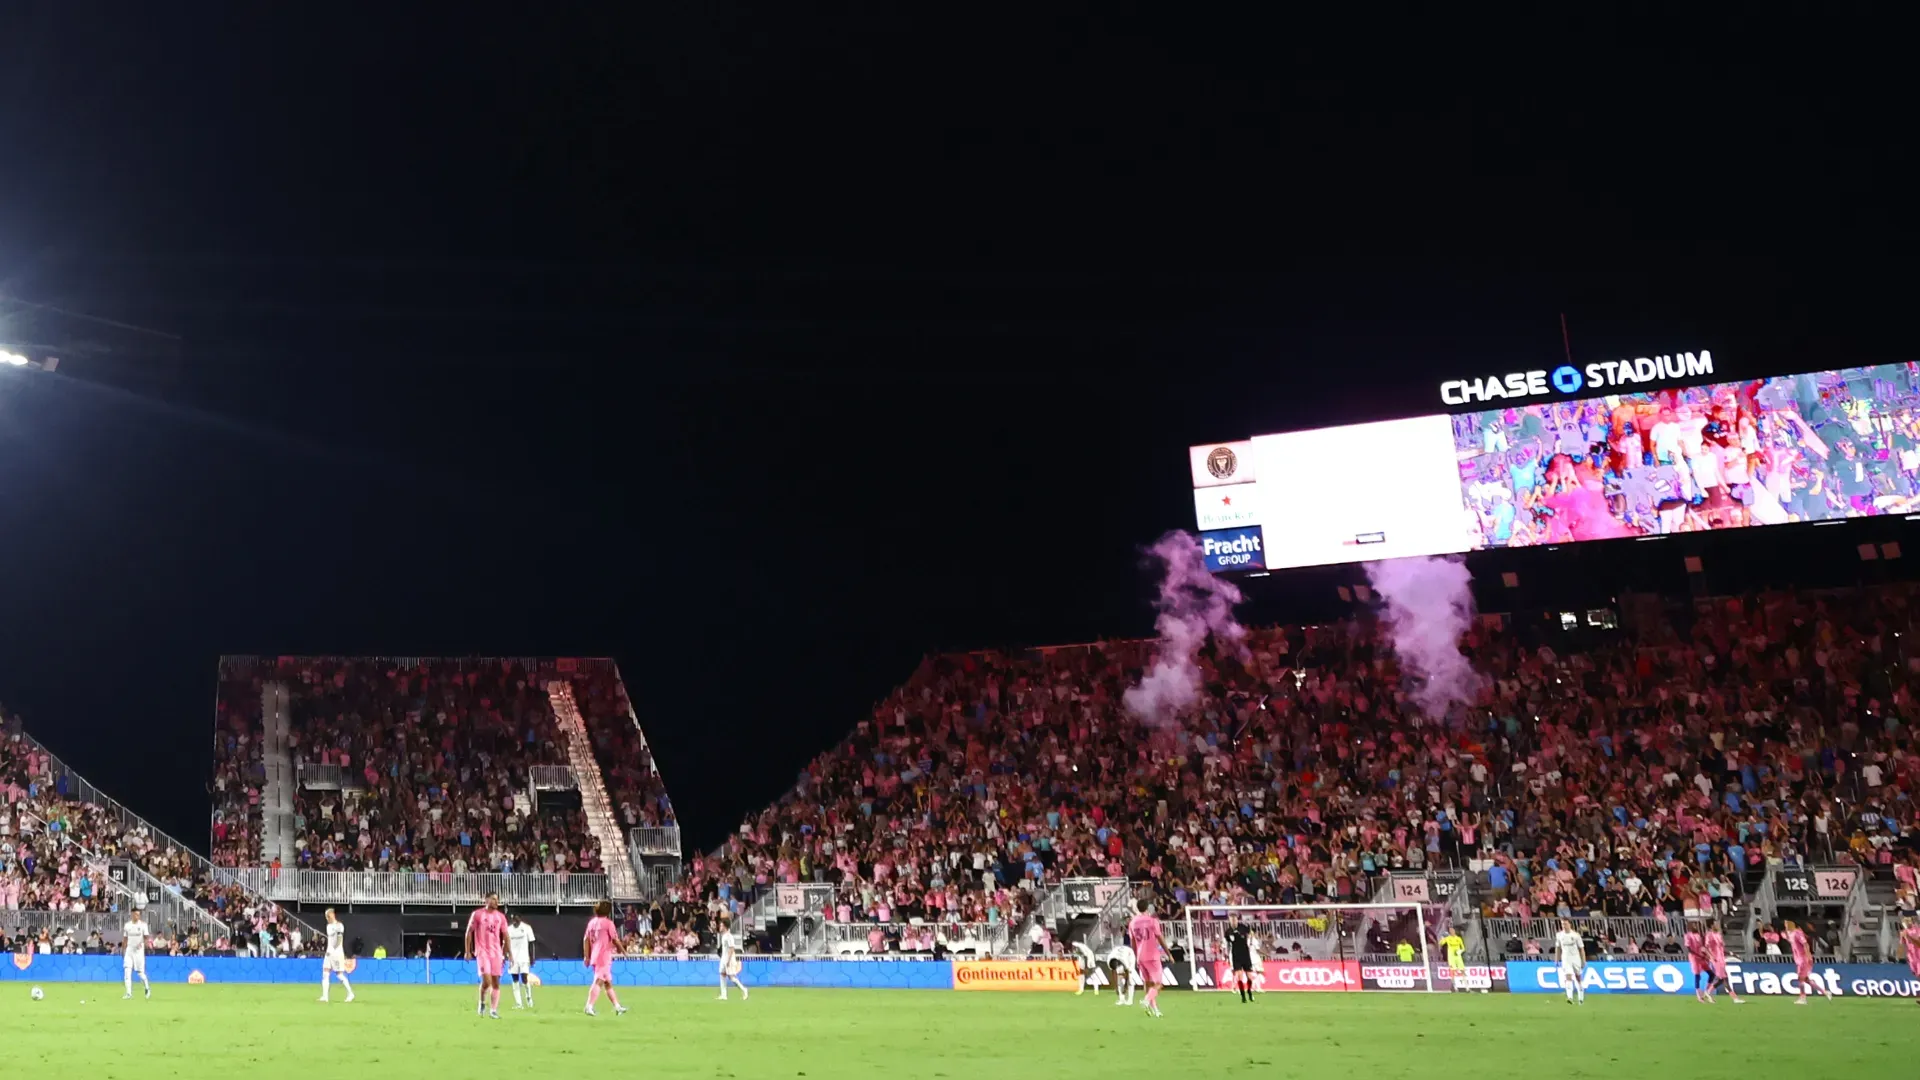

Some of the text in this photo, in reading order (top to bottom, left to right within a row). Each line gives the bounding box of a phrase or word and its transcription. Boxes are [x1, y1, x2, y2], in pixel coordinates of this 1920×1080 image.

[1440, 350, 1714, 404] CHASE STADIUM
[1203, 534, 1261, 555] Fracht
[1218, 554, 1251, 565] GROUP
[113, 870, 123, 880] 121
[1785, 878, 1809, 890] 125
[1825, 879, 1849, 890] 126
[1072, 890, 1090, 901] 123
[1401, 885, 1421, 896] 124
[783, 895, 799, 904] 122
[957, 967, 1033, 984] Continental
[1363, 967, 1427, 978] DISCOUNT
